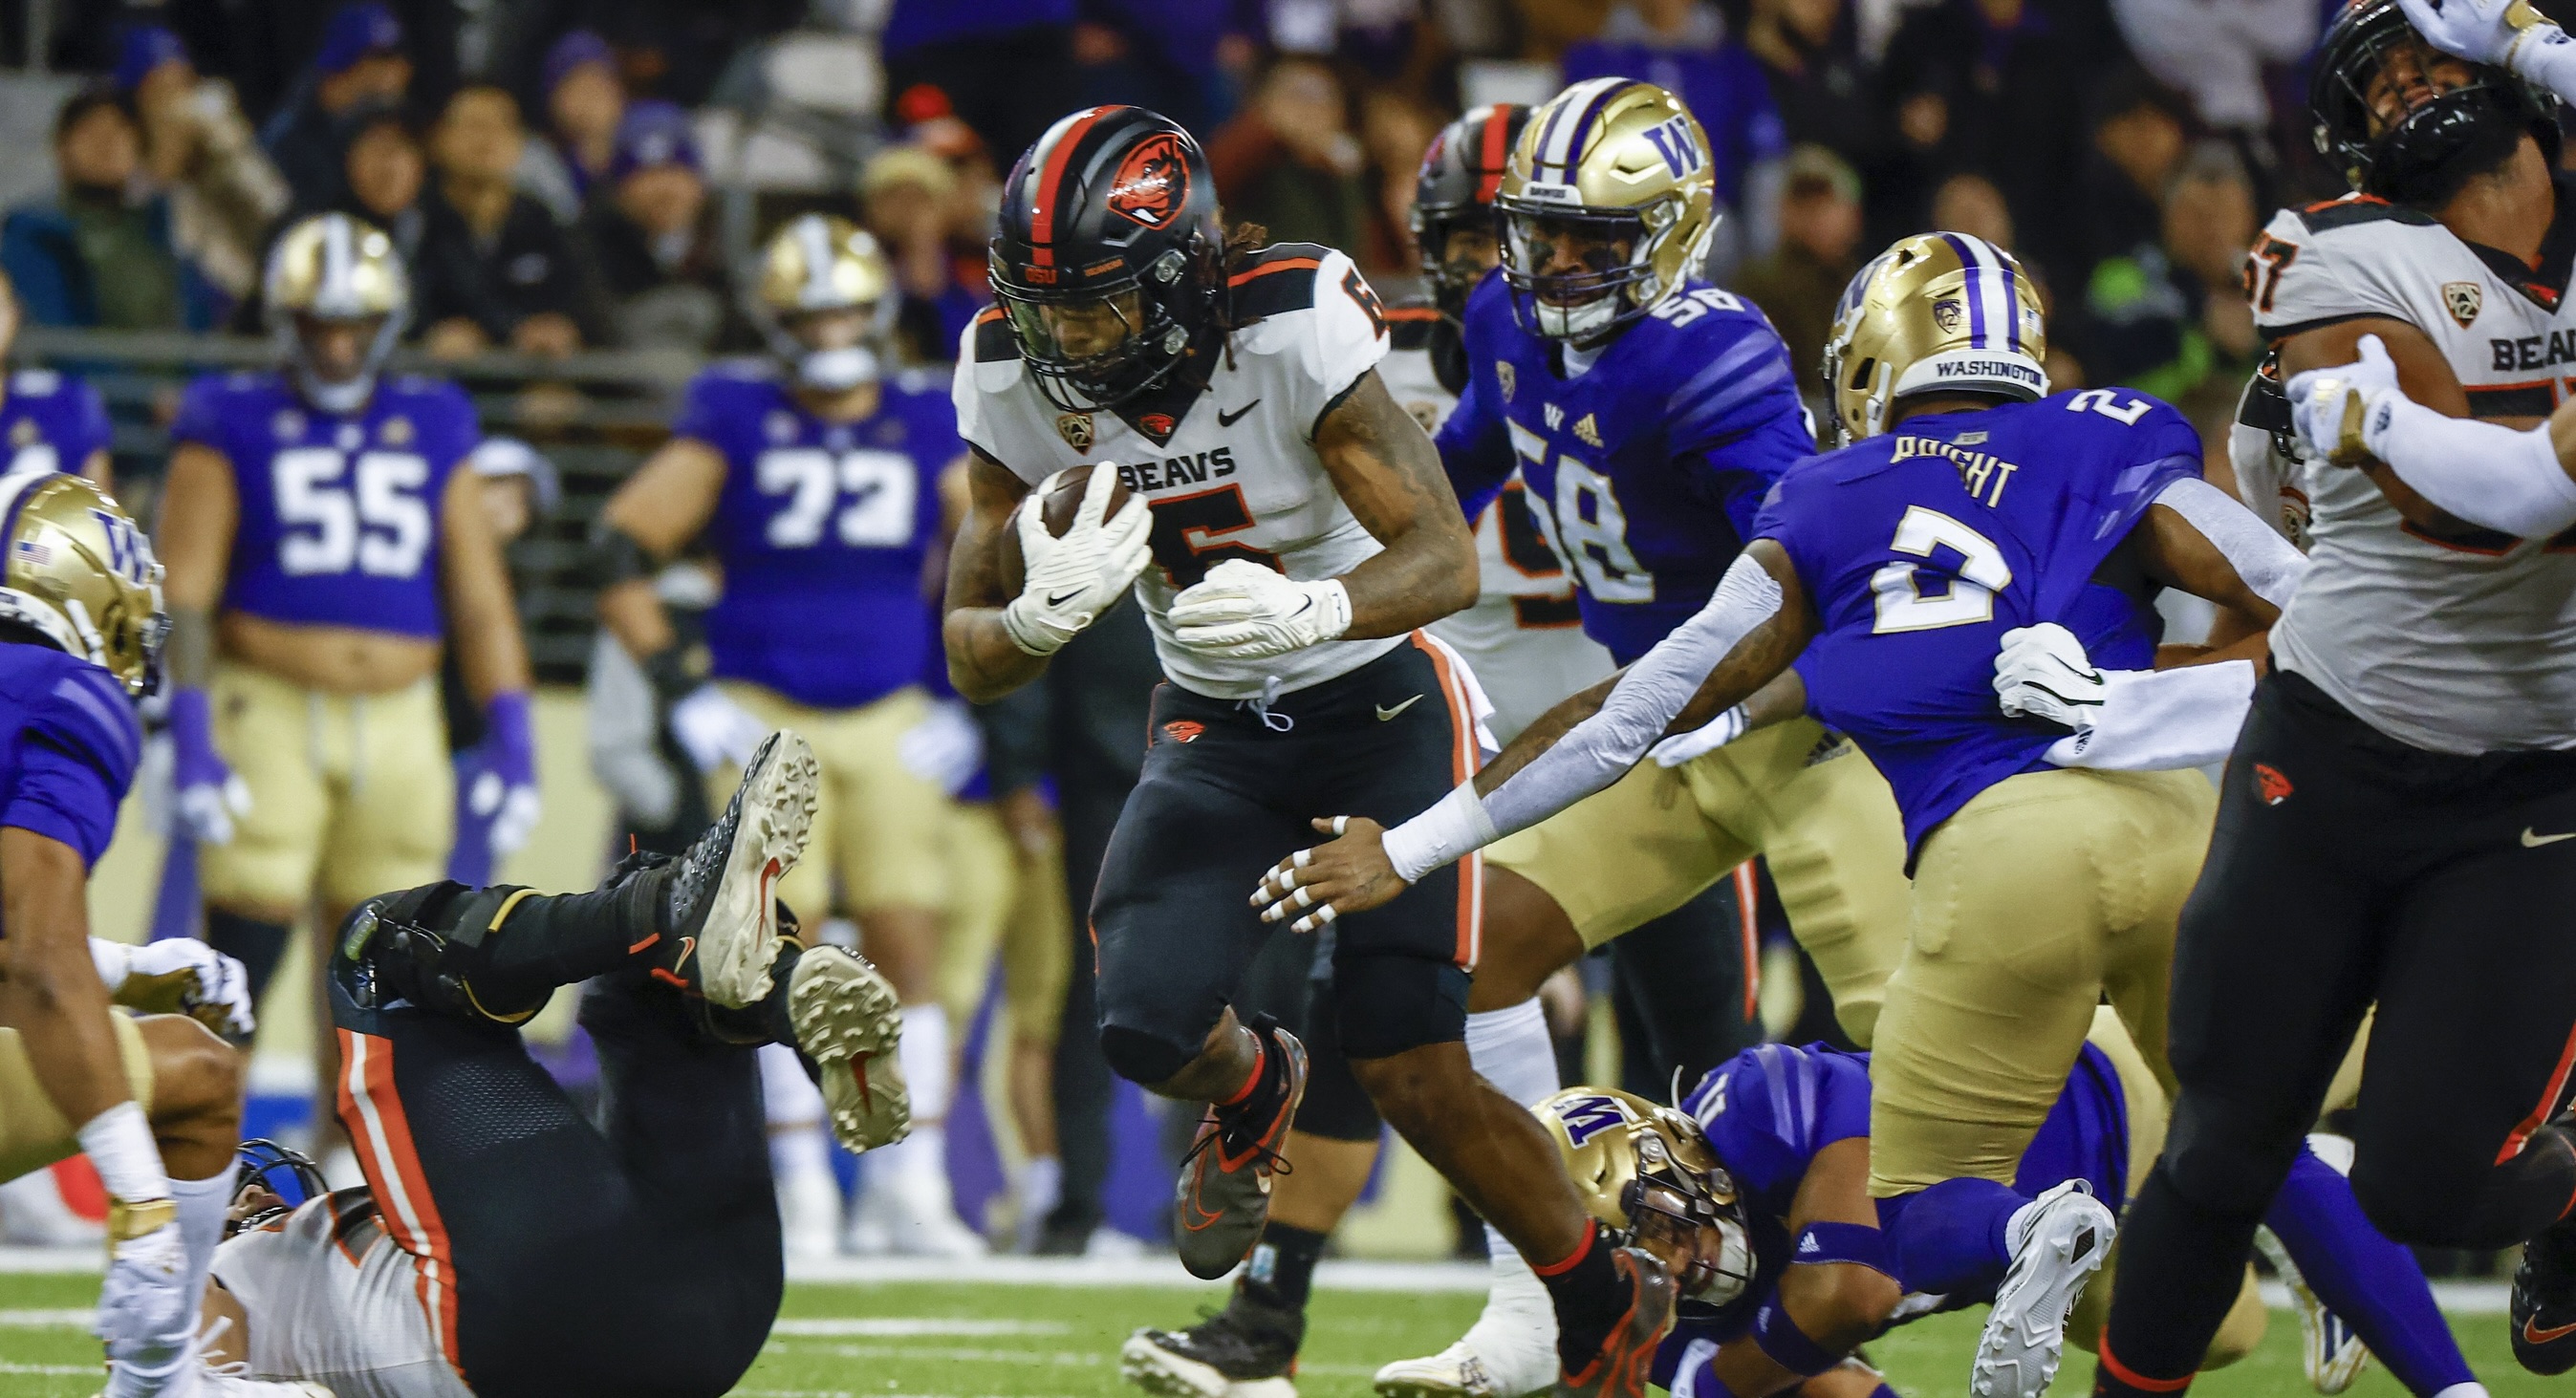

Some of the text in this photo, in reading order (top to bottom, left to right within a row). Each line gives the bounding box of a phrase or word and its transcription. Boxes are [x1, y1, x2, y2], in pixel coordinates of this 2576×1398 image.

[1641, 113, 1701, 183] W
[1650, 286, 1745, 329] 58
[1543, 401, 1565, 431] W
[2065, 388, 2153, 427] 2
[271, 446, 432, 577] 55
[1504, 415, 1656, 604] 58
[1870, 504, 2013, 634] 2
